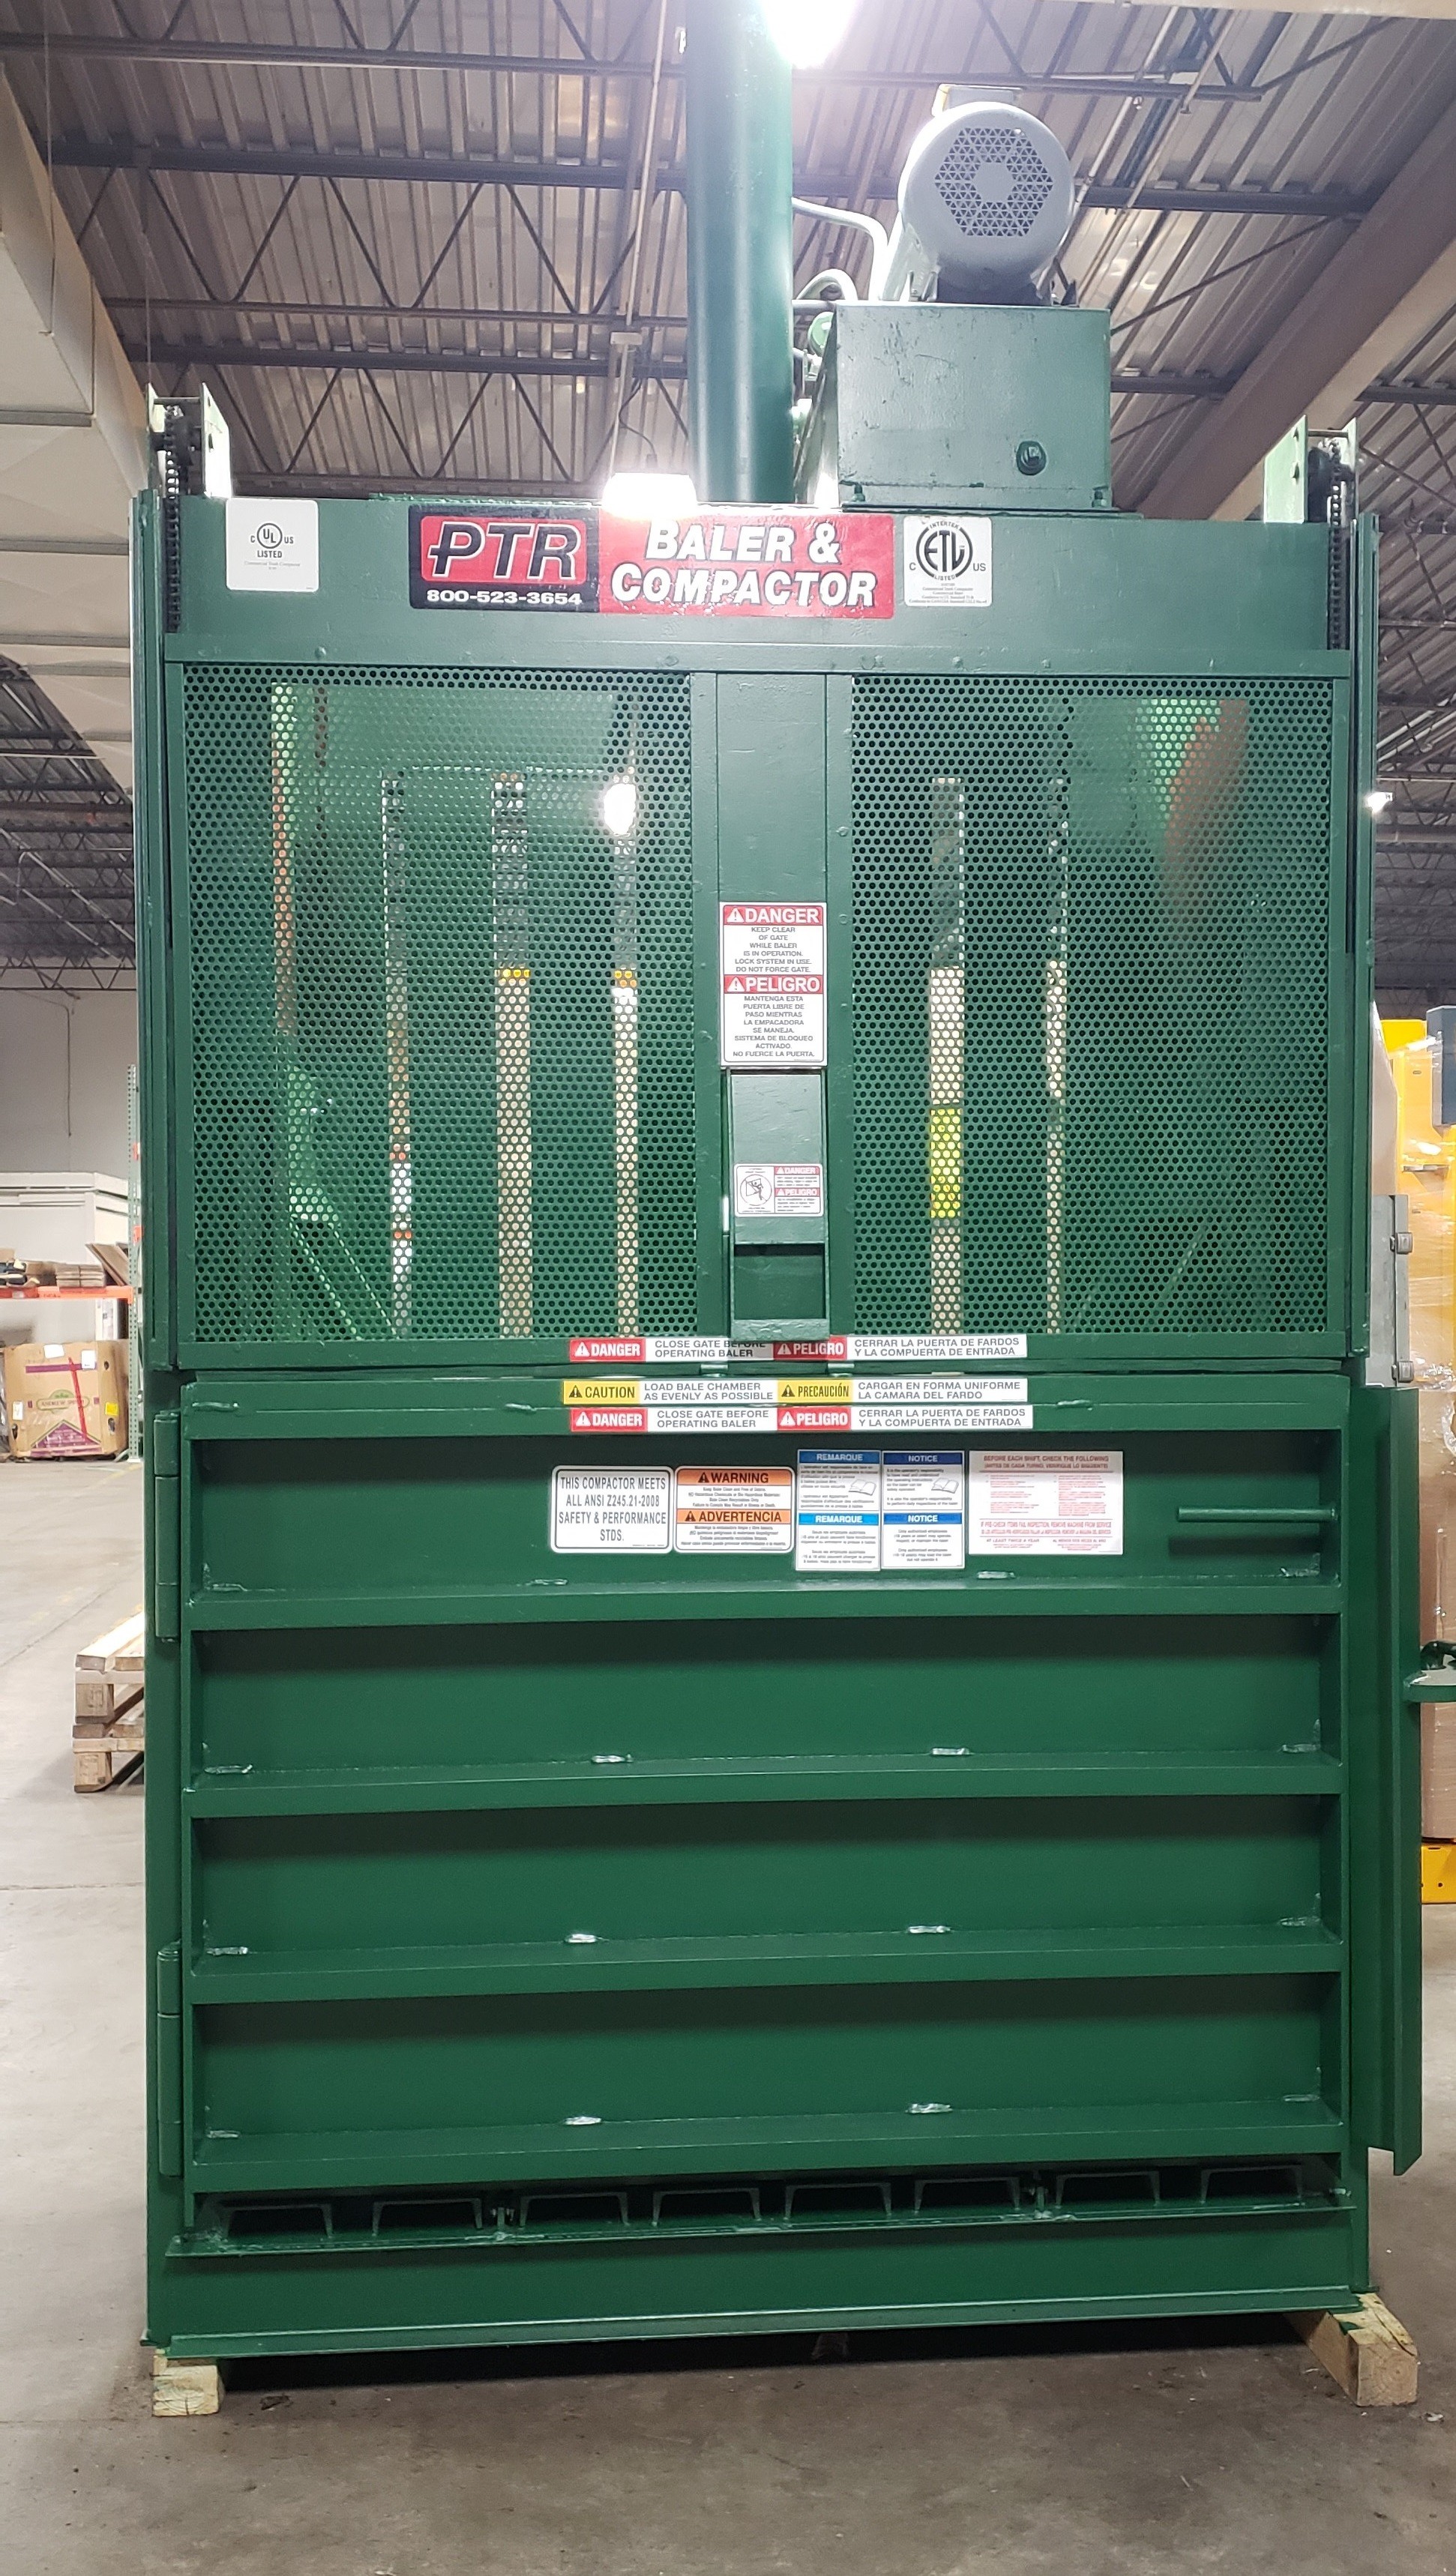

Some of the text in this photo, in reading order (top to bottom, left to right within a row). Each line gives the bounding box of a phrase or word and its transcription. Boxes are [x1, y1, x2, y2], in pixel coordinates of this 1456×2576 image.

[930, 521, 959, 529] INTERTEK
[646, 522, 841, 566] BALER &
[427, 521, 583, 581] PTR
[909, 530, 986, 572] C ETL US
[610, 563, 878, 607] COMPACTOR
[427, 588, 583, 606] 800-523-3654
[745, 908, 819, 923] DANGER
[745, 977, 820, 992] PELIGRO
[793, 1342, 843, 1355] PELIGRO
[901, 1339, 913, 1347] LA
[591, 1343, 640, 1357] DANGER
[864, 1348, 877, 1357] LA
[949, 1348, 963, 1356] DE
[585, 1387, 634, 1399] CAUTION
[798, 1383, 849, 1397] PRECAUCIÓN
[922, 1409, 963, 1417] PUERTA
[592, 1413, 642, 1427] DANGER
[796, 1413, 848, 1426] PELIGRO
[858, 1419, 865, 1427] Y
[869, 1419, 882, 1427] LA
[561, 1477, 666, 1489] THIS COMPACTOR MEETS
[711, 1473, 768, 1482] WARNING
[566, 1494, 660, 1506] ALL ANSI Z245.21-2008
[559, 1512, 666, 1524] SAFETY & PERFORMANCE
[699, 1511, 781, 1522] ADVERTENCIA
[600, 1529, 624, 1541] STDS.
